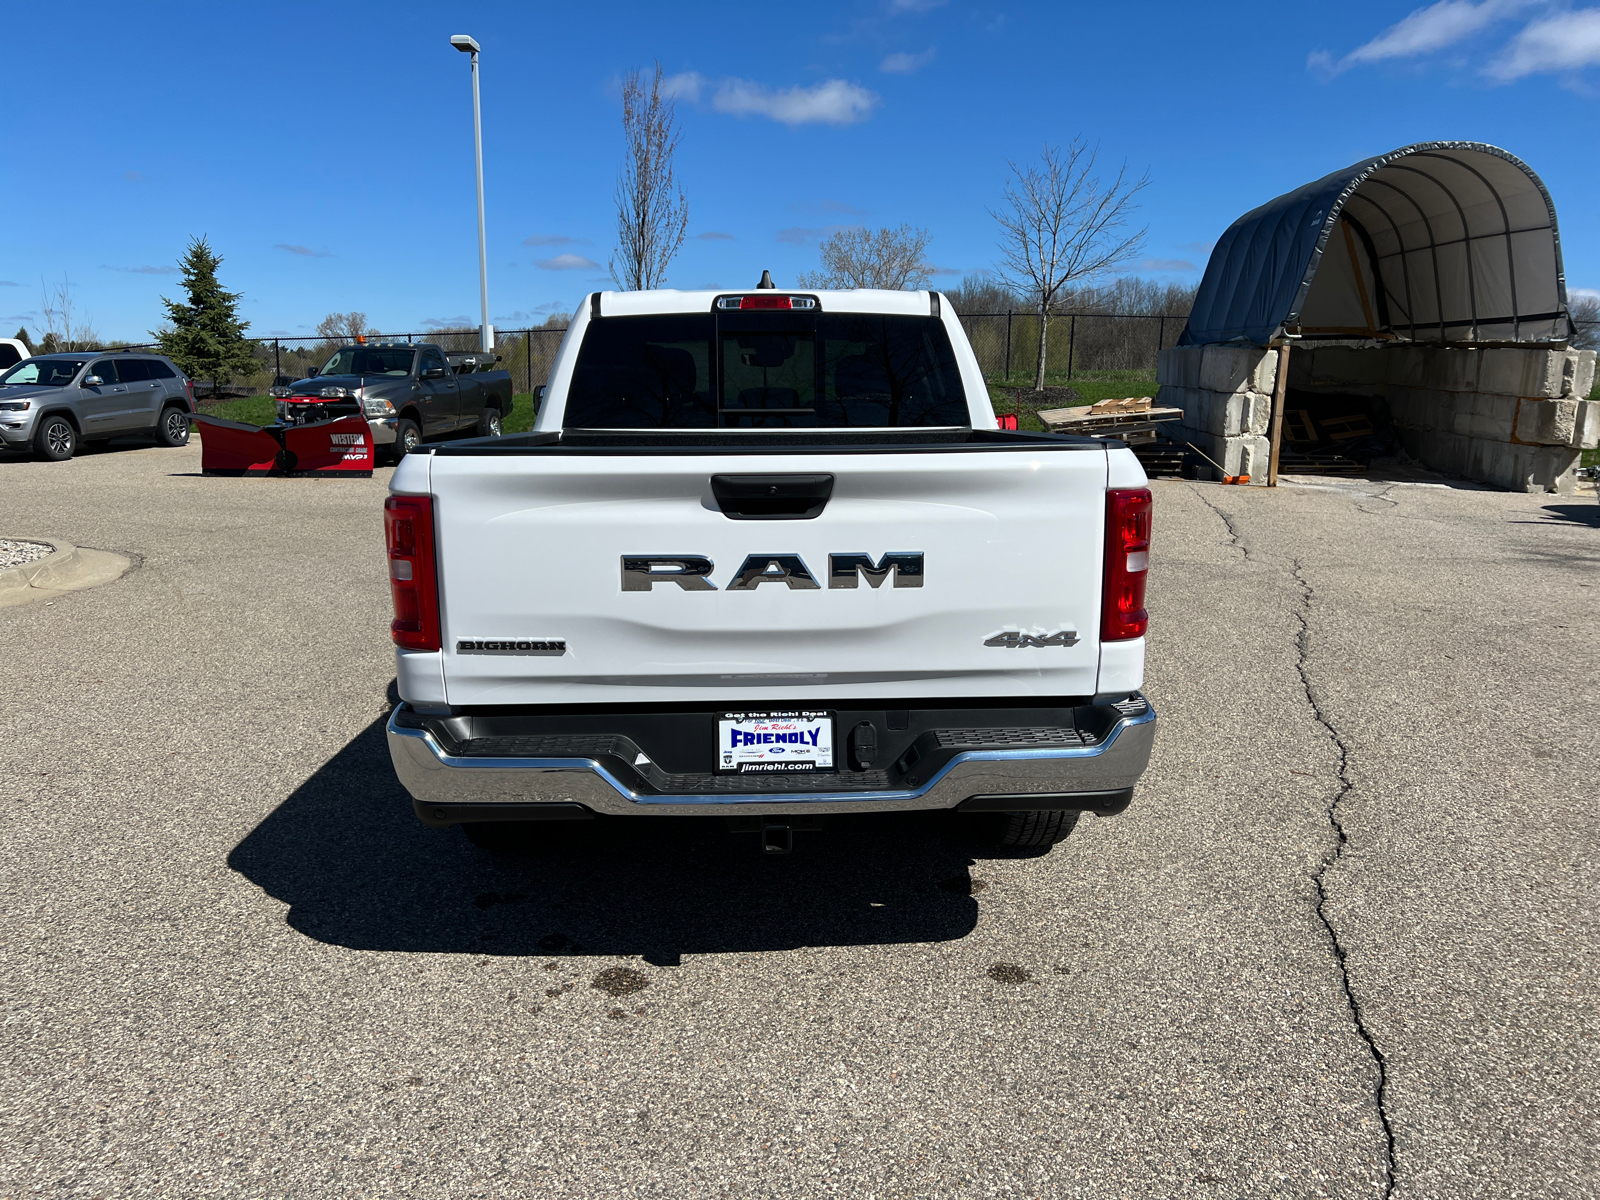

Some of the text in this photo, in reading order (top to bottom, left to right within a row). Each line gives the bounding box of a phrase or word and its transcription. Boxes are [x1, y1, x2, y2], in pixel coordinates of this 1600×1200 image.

[330, 434, 365, 445] WESTERN
[620, 551, 925, 591] RAM
[456, 640, 566, 655] BIGHORN
[753, 723, 797, 732] Jim Riehl's
[731, 726, 821, 748] FRIENDLY
[740, 762, 813, 773] jimriehl.com
